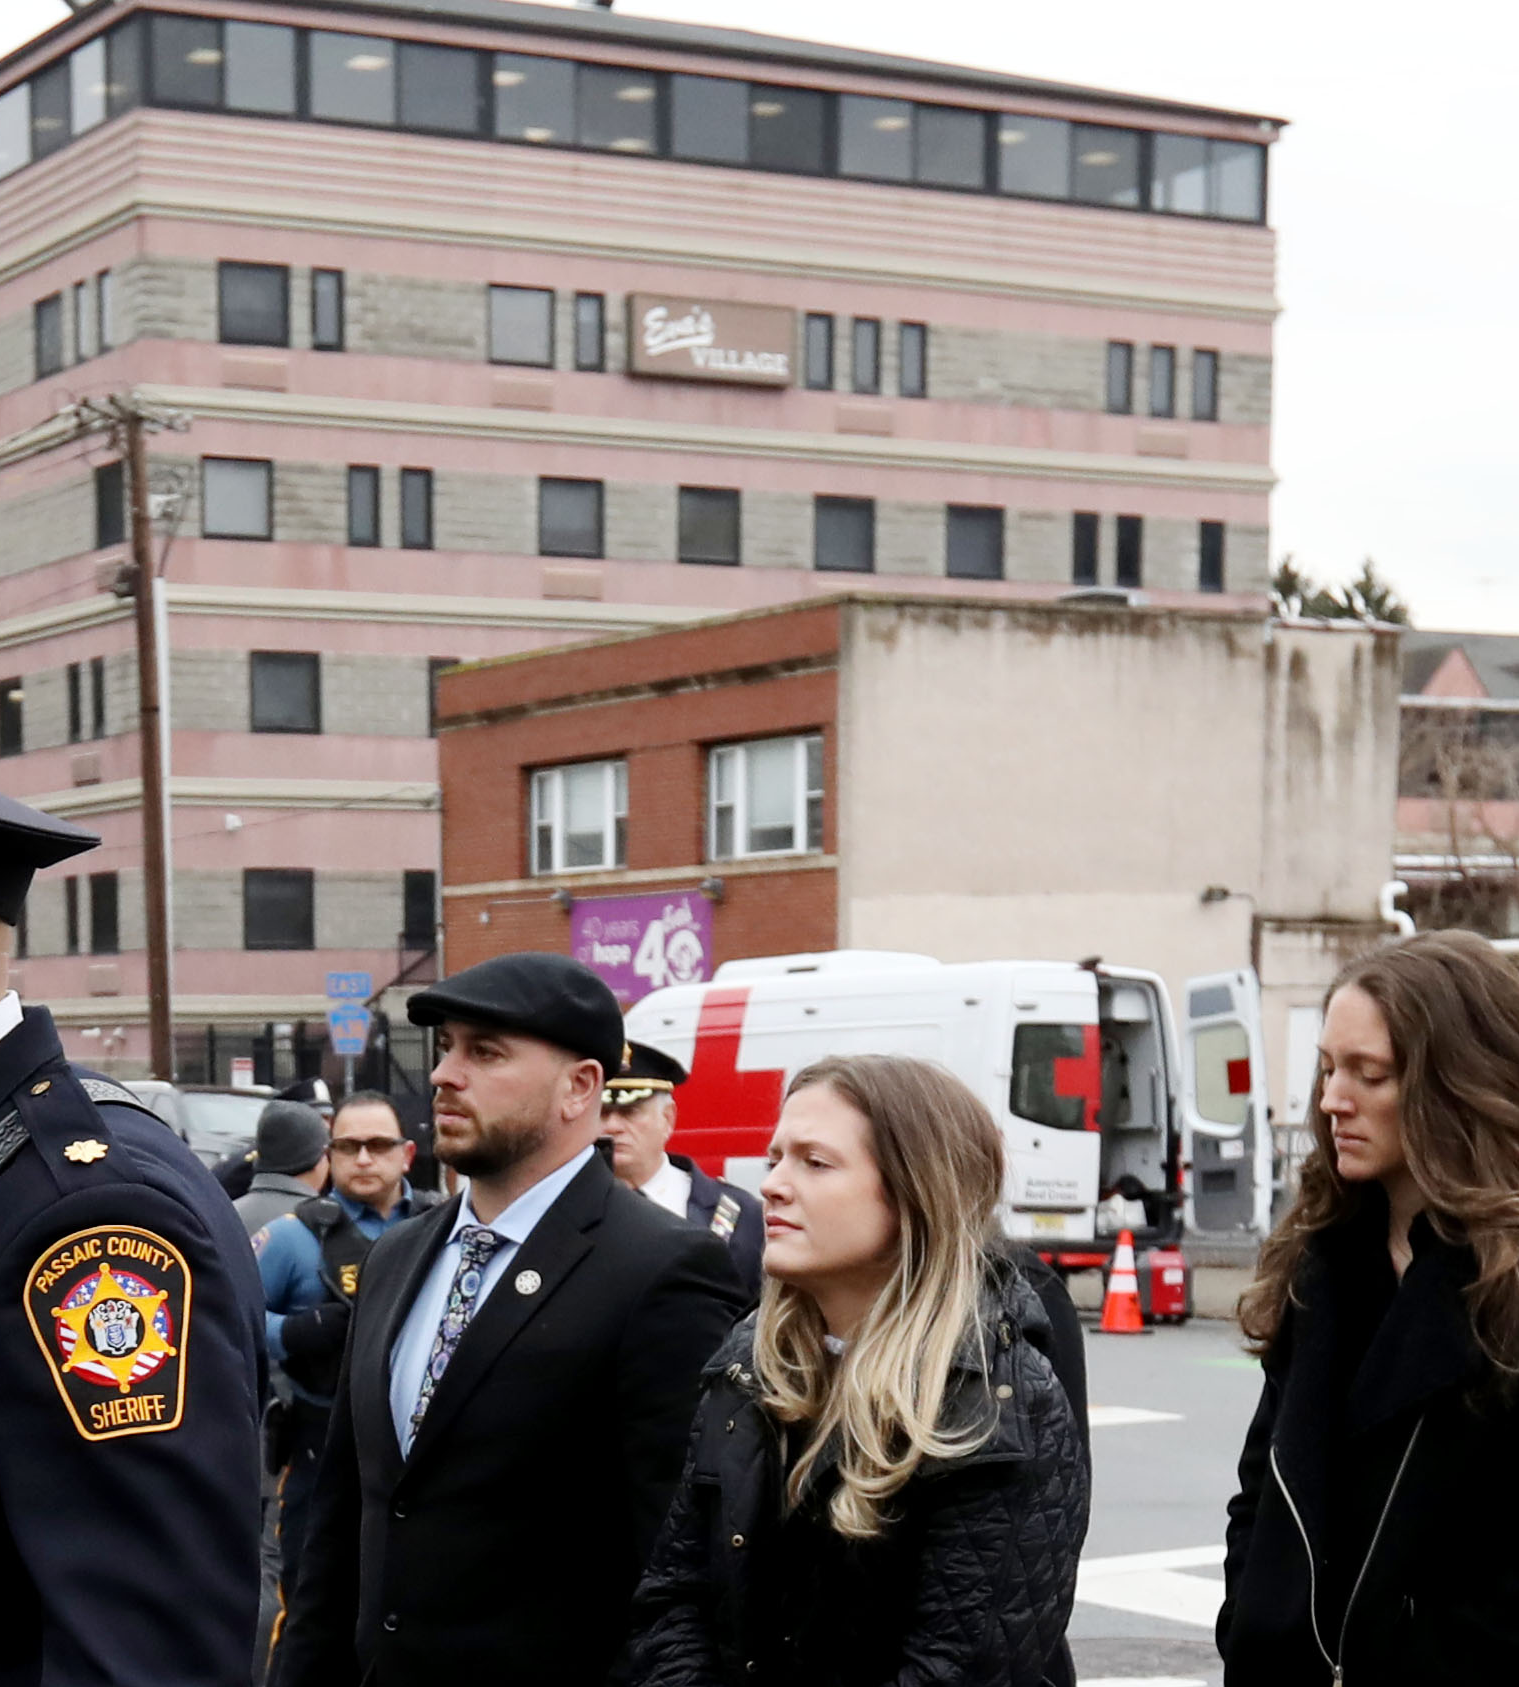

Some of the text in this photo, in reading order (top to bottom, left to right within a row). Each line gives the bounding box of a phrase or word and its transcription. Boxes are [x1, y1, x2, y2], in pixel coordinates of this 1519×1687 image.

[690, 347, 789, 376] VILLAGE
[603, 920, 641, 943] years
[593, 940, 632, 967] hope
[35, 1236, 176, 1294] PASSAIC COUNTY
[89, 1394, 167, 1430] SHERIFF
